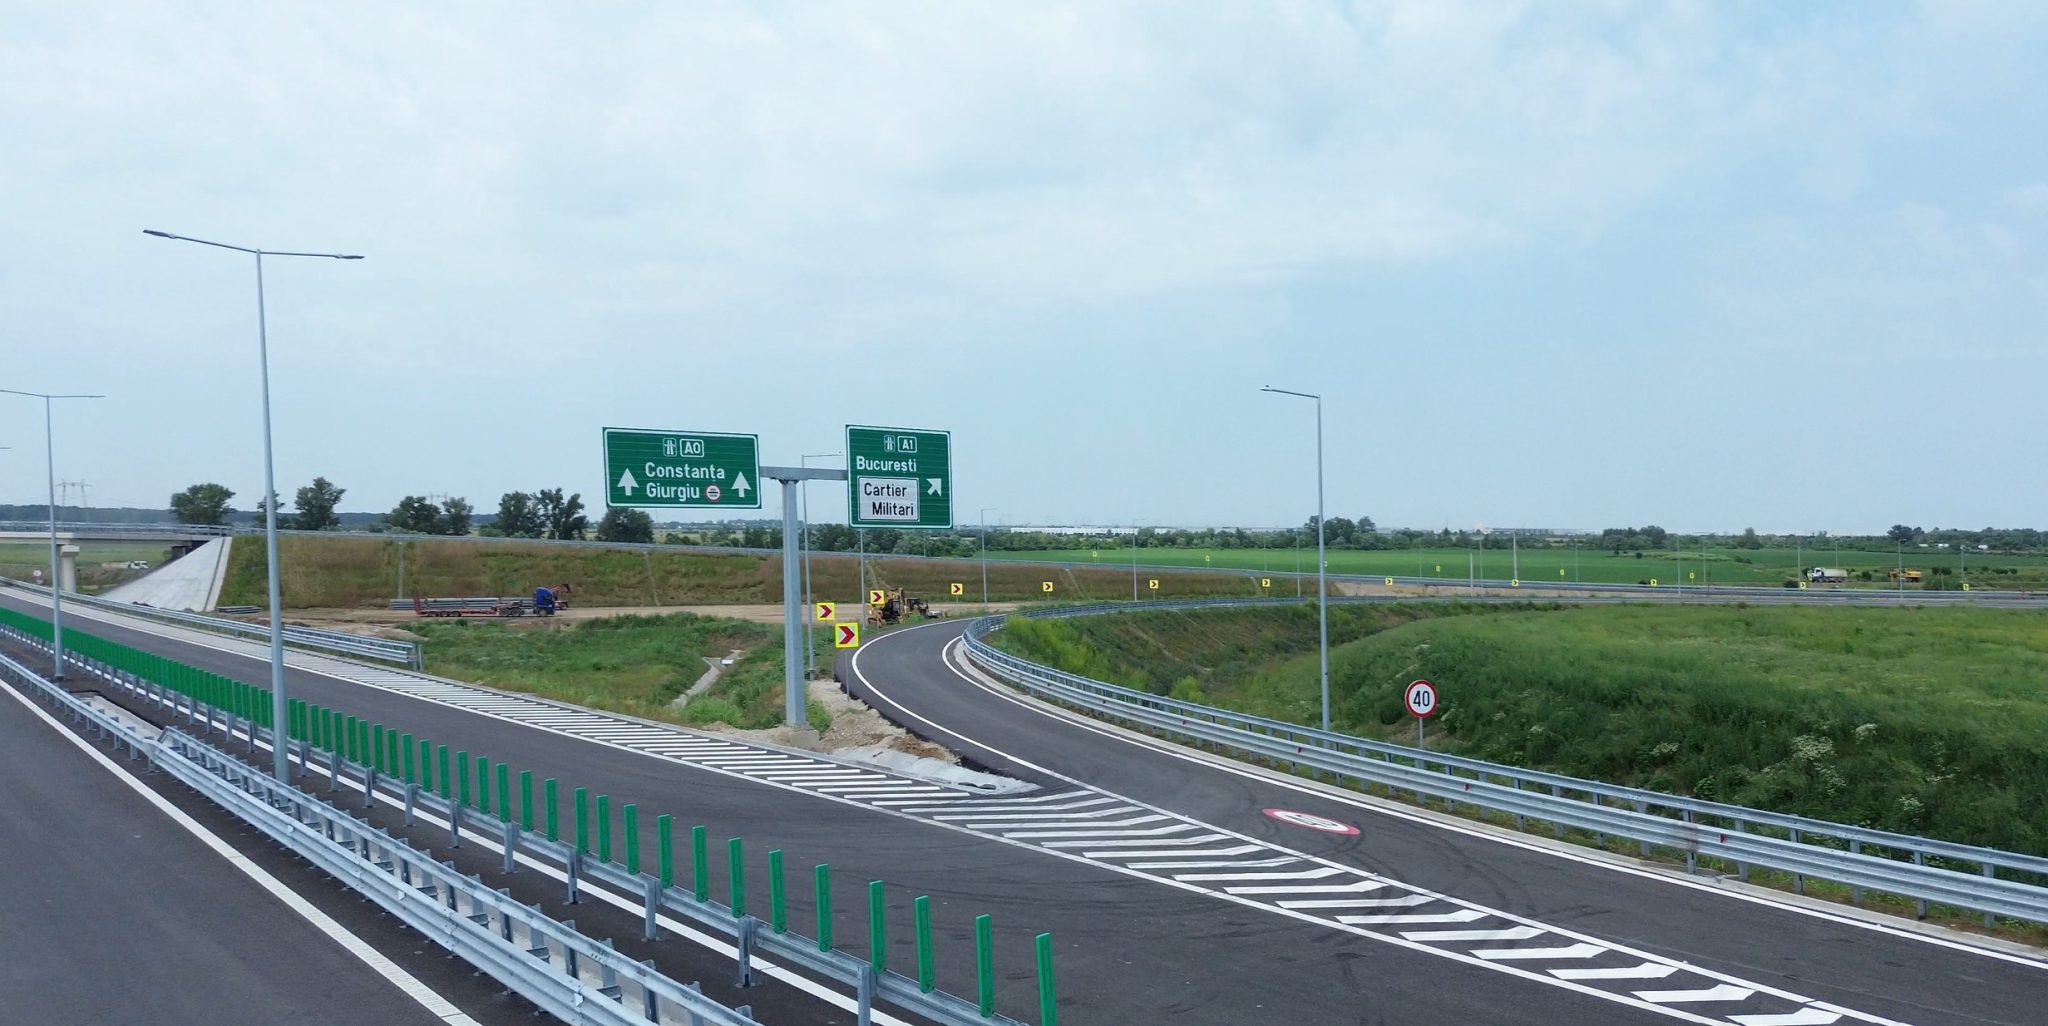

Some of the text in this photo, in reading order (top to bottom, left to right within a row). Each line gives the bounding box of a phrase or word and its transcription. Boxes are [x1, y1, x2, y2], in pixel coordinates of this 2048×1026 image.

[684, 441, 701, 454] A0
[902, 439, 913, 450] A1
[646, 482, 699, 502] Giurgiu
[864, 482, 907, 497] Cartier
[872, 501, 914, 516] Militari
[1413, 690, 1430, 707] 40
